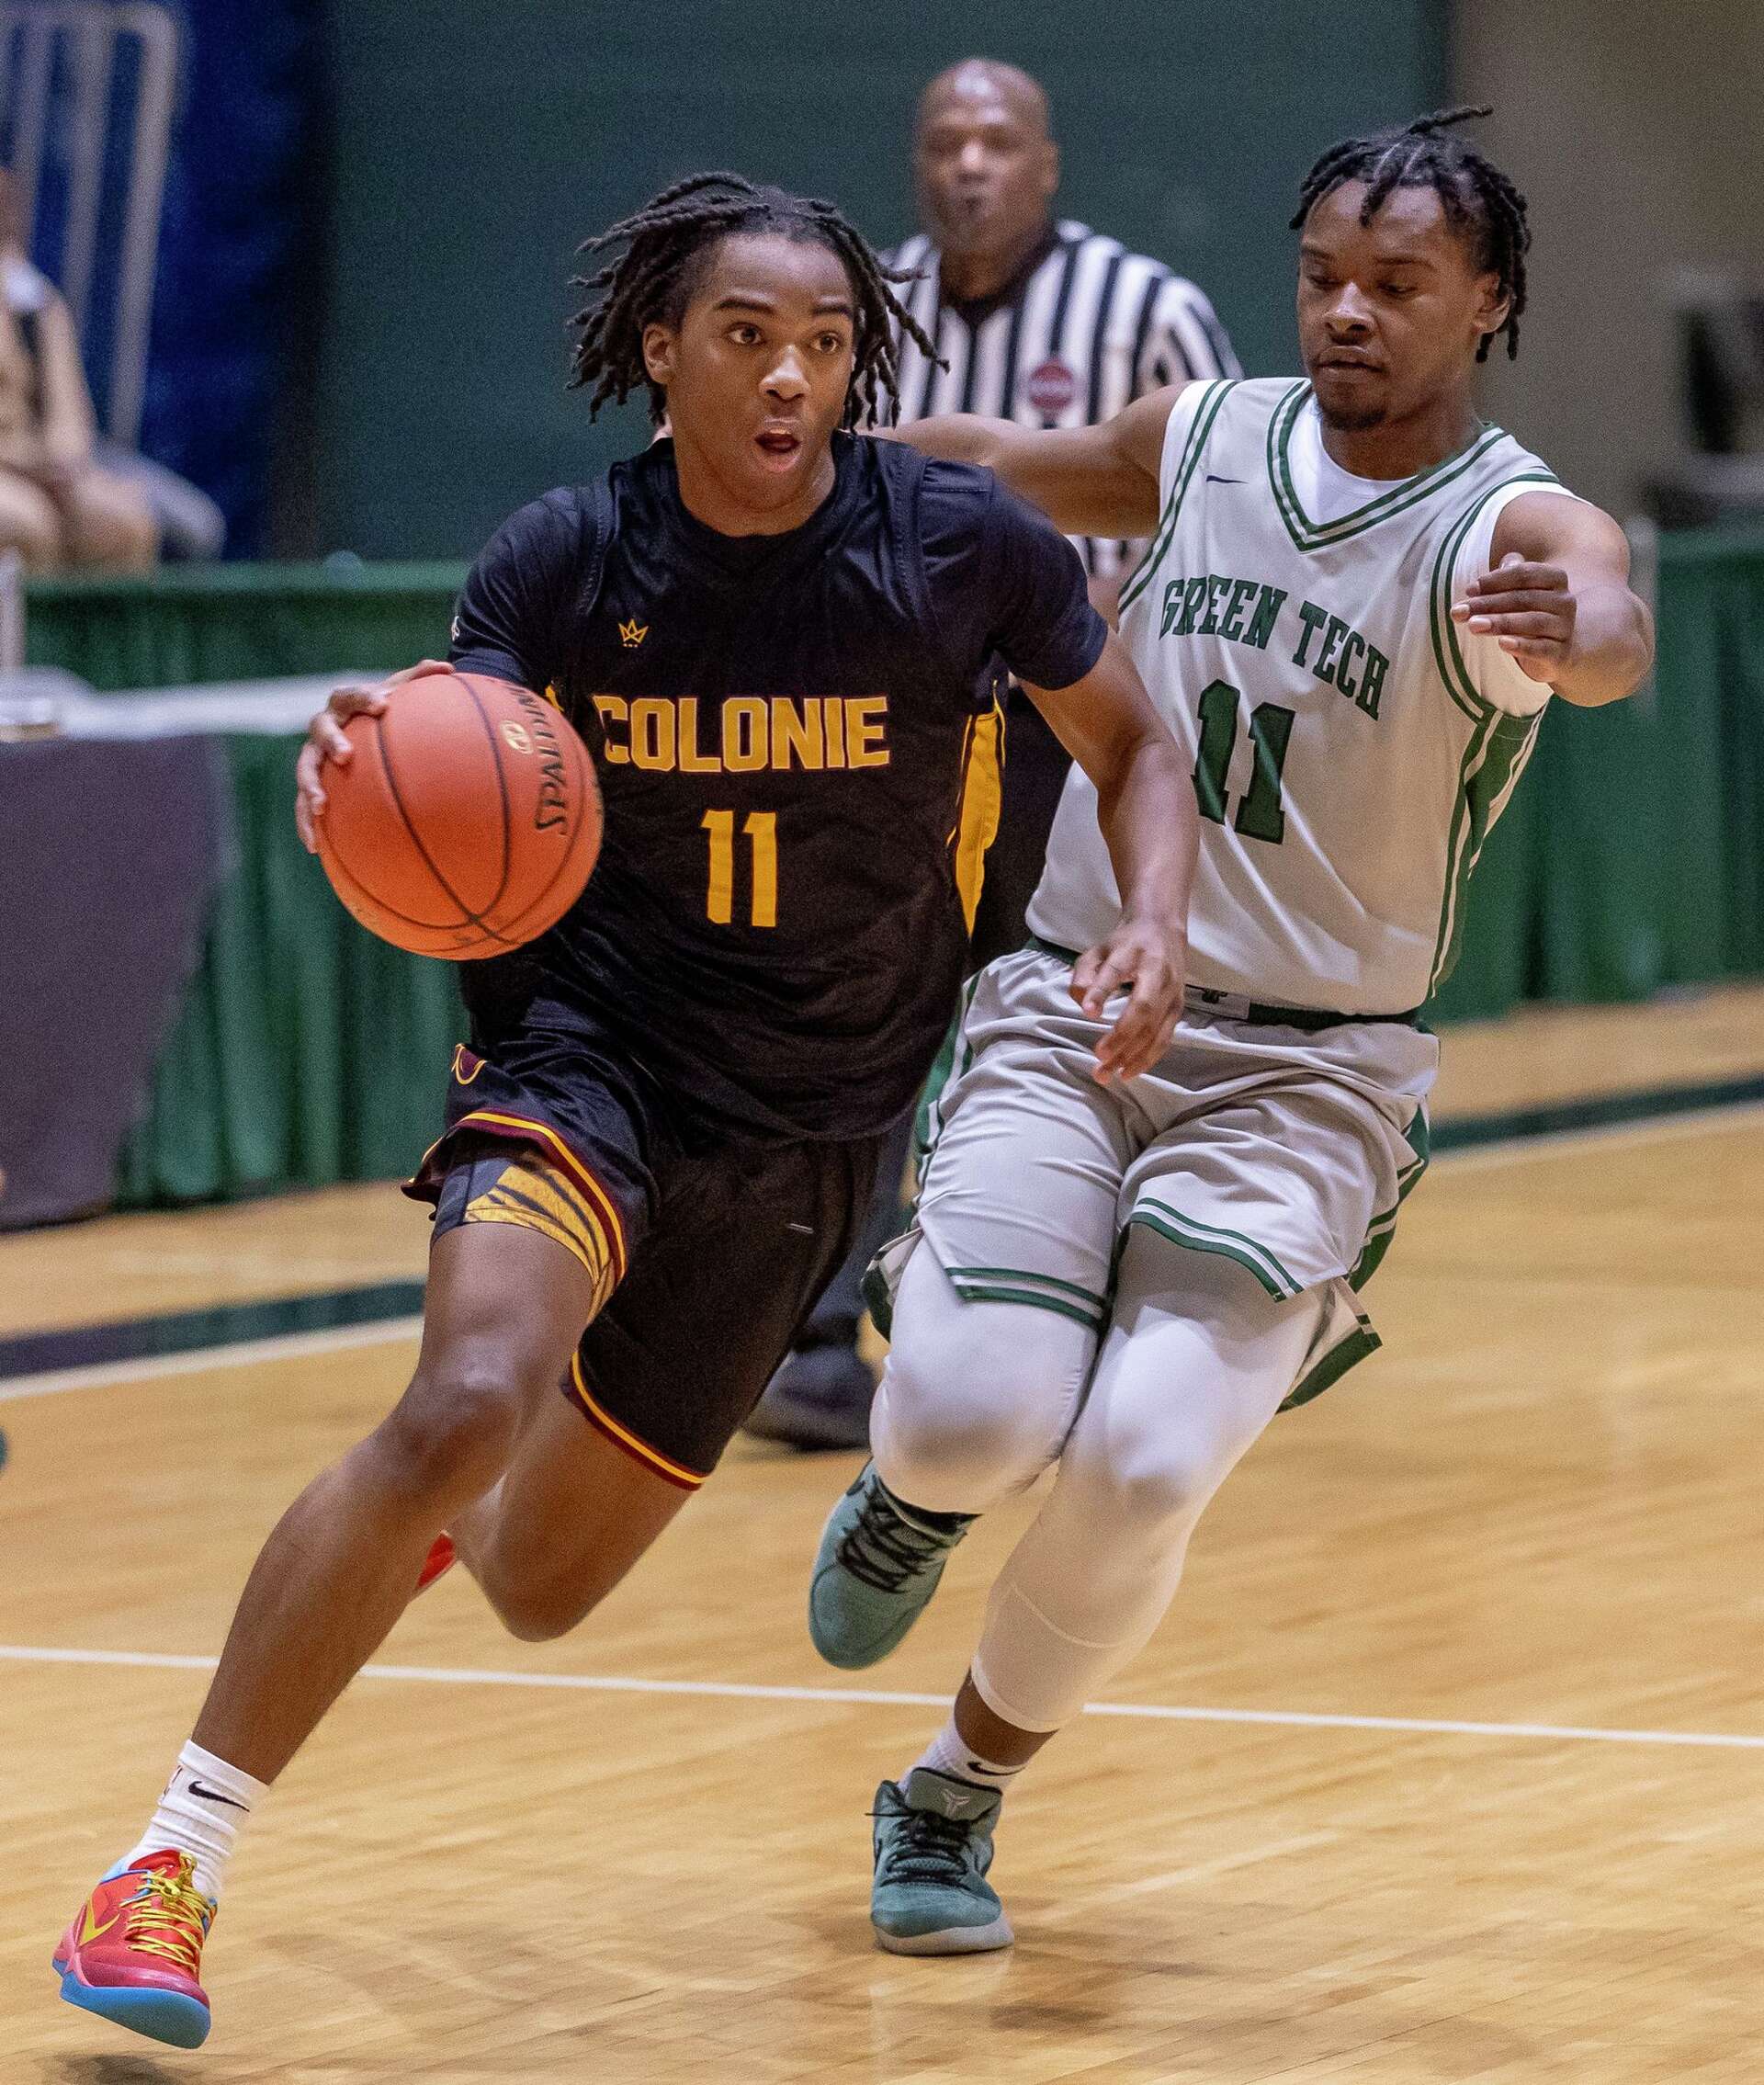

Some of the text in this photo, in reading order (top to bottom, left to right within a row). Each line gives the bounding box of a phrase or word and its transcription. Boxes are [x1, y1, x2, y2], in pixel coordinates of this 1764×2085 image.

[1159, 573, 1390, 721] GREEN TECH
[507, 684, 569, 837] SPALDIN
[593, 695, 891, 773] COLONIE
[1190, 678, 1296, 844] 11
[701, 809, 778, 927] 11
